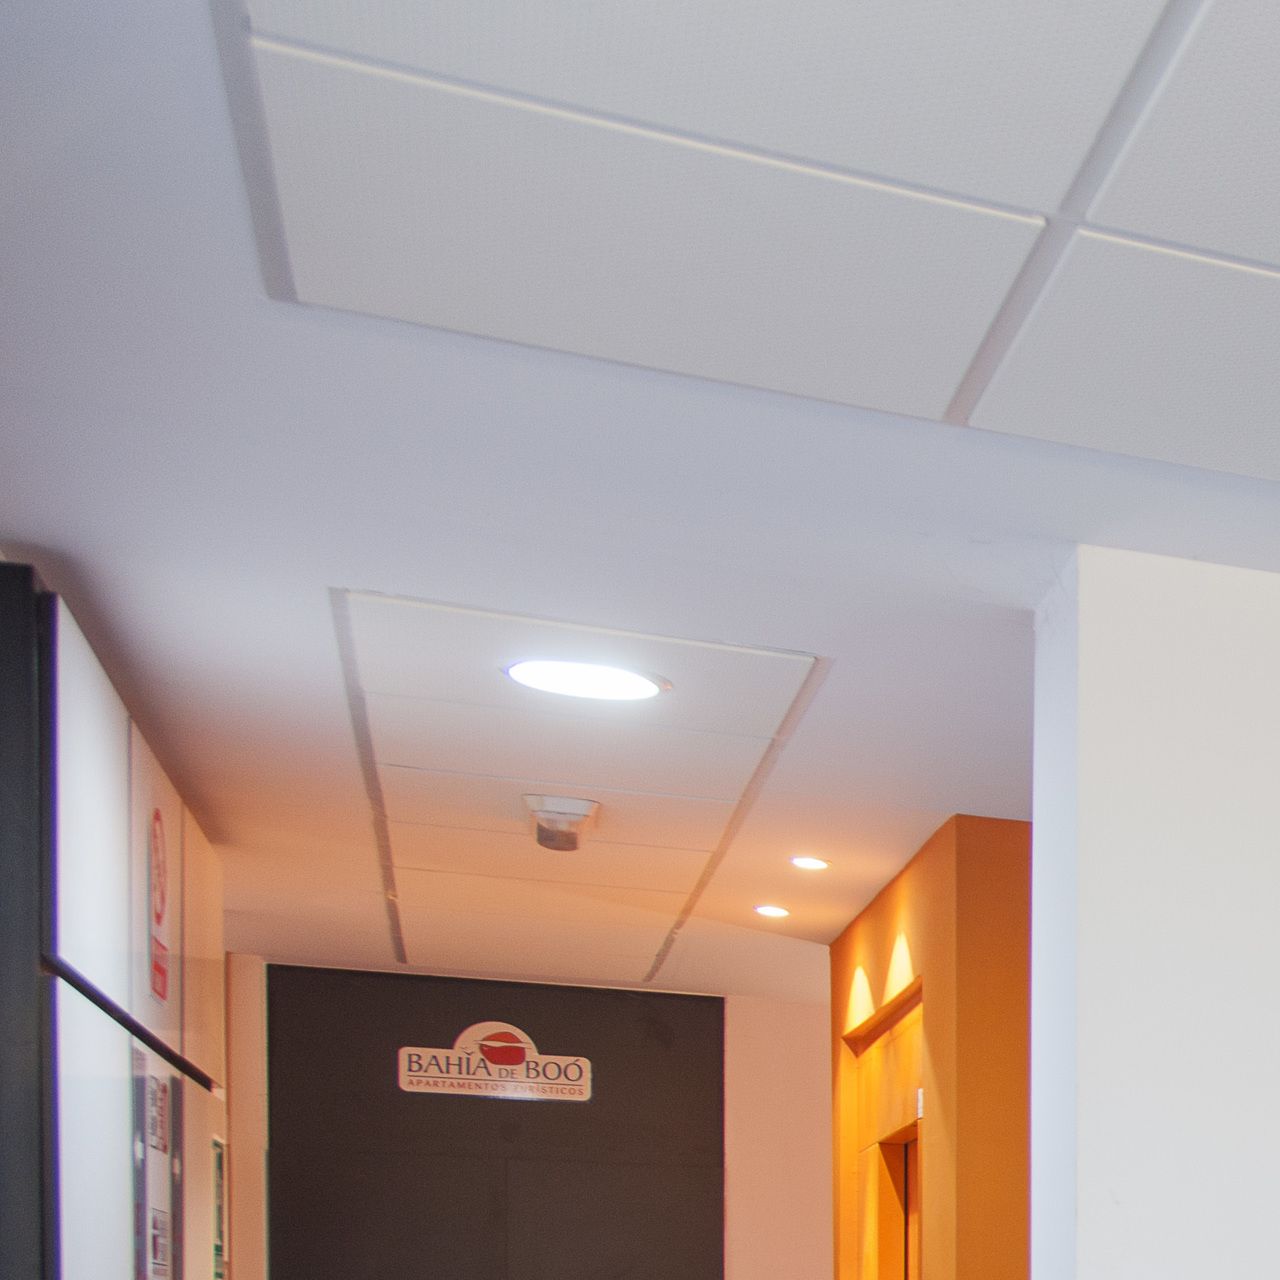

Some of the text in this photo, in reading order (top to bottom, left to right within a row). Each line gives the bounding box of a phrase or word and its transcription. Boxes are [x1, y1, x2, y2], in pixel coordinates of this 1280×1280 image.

[499, 1067, 518, 1079] DE
[525, 1059, 583, 1082] BOÓ
[407, 1078, 507, 1092] APARTAMENTOS
